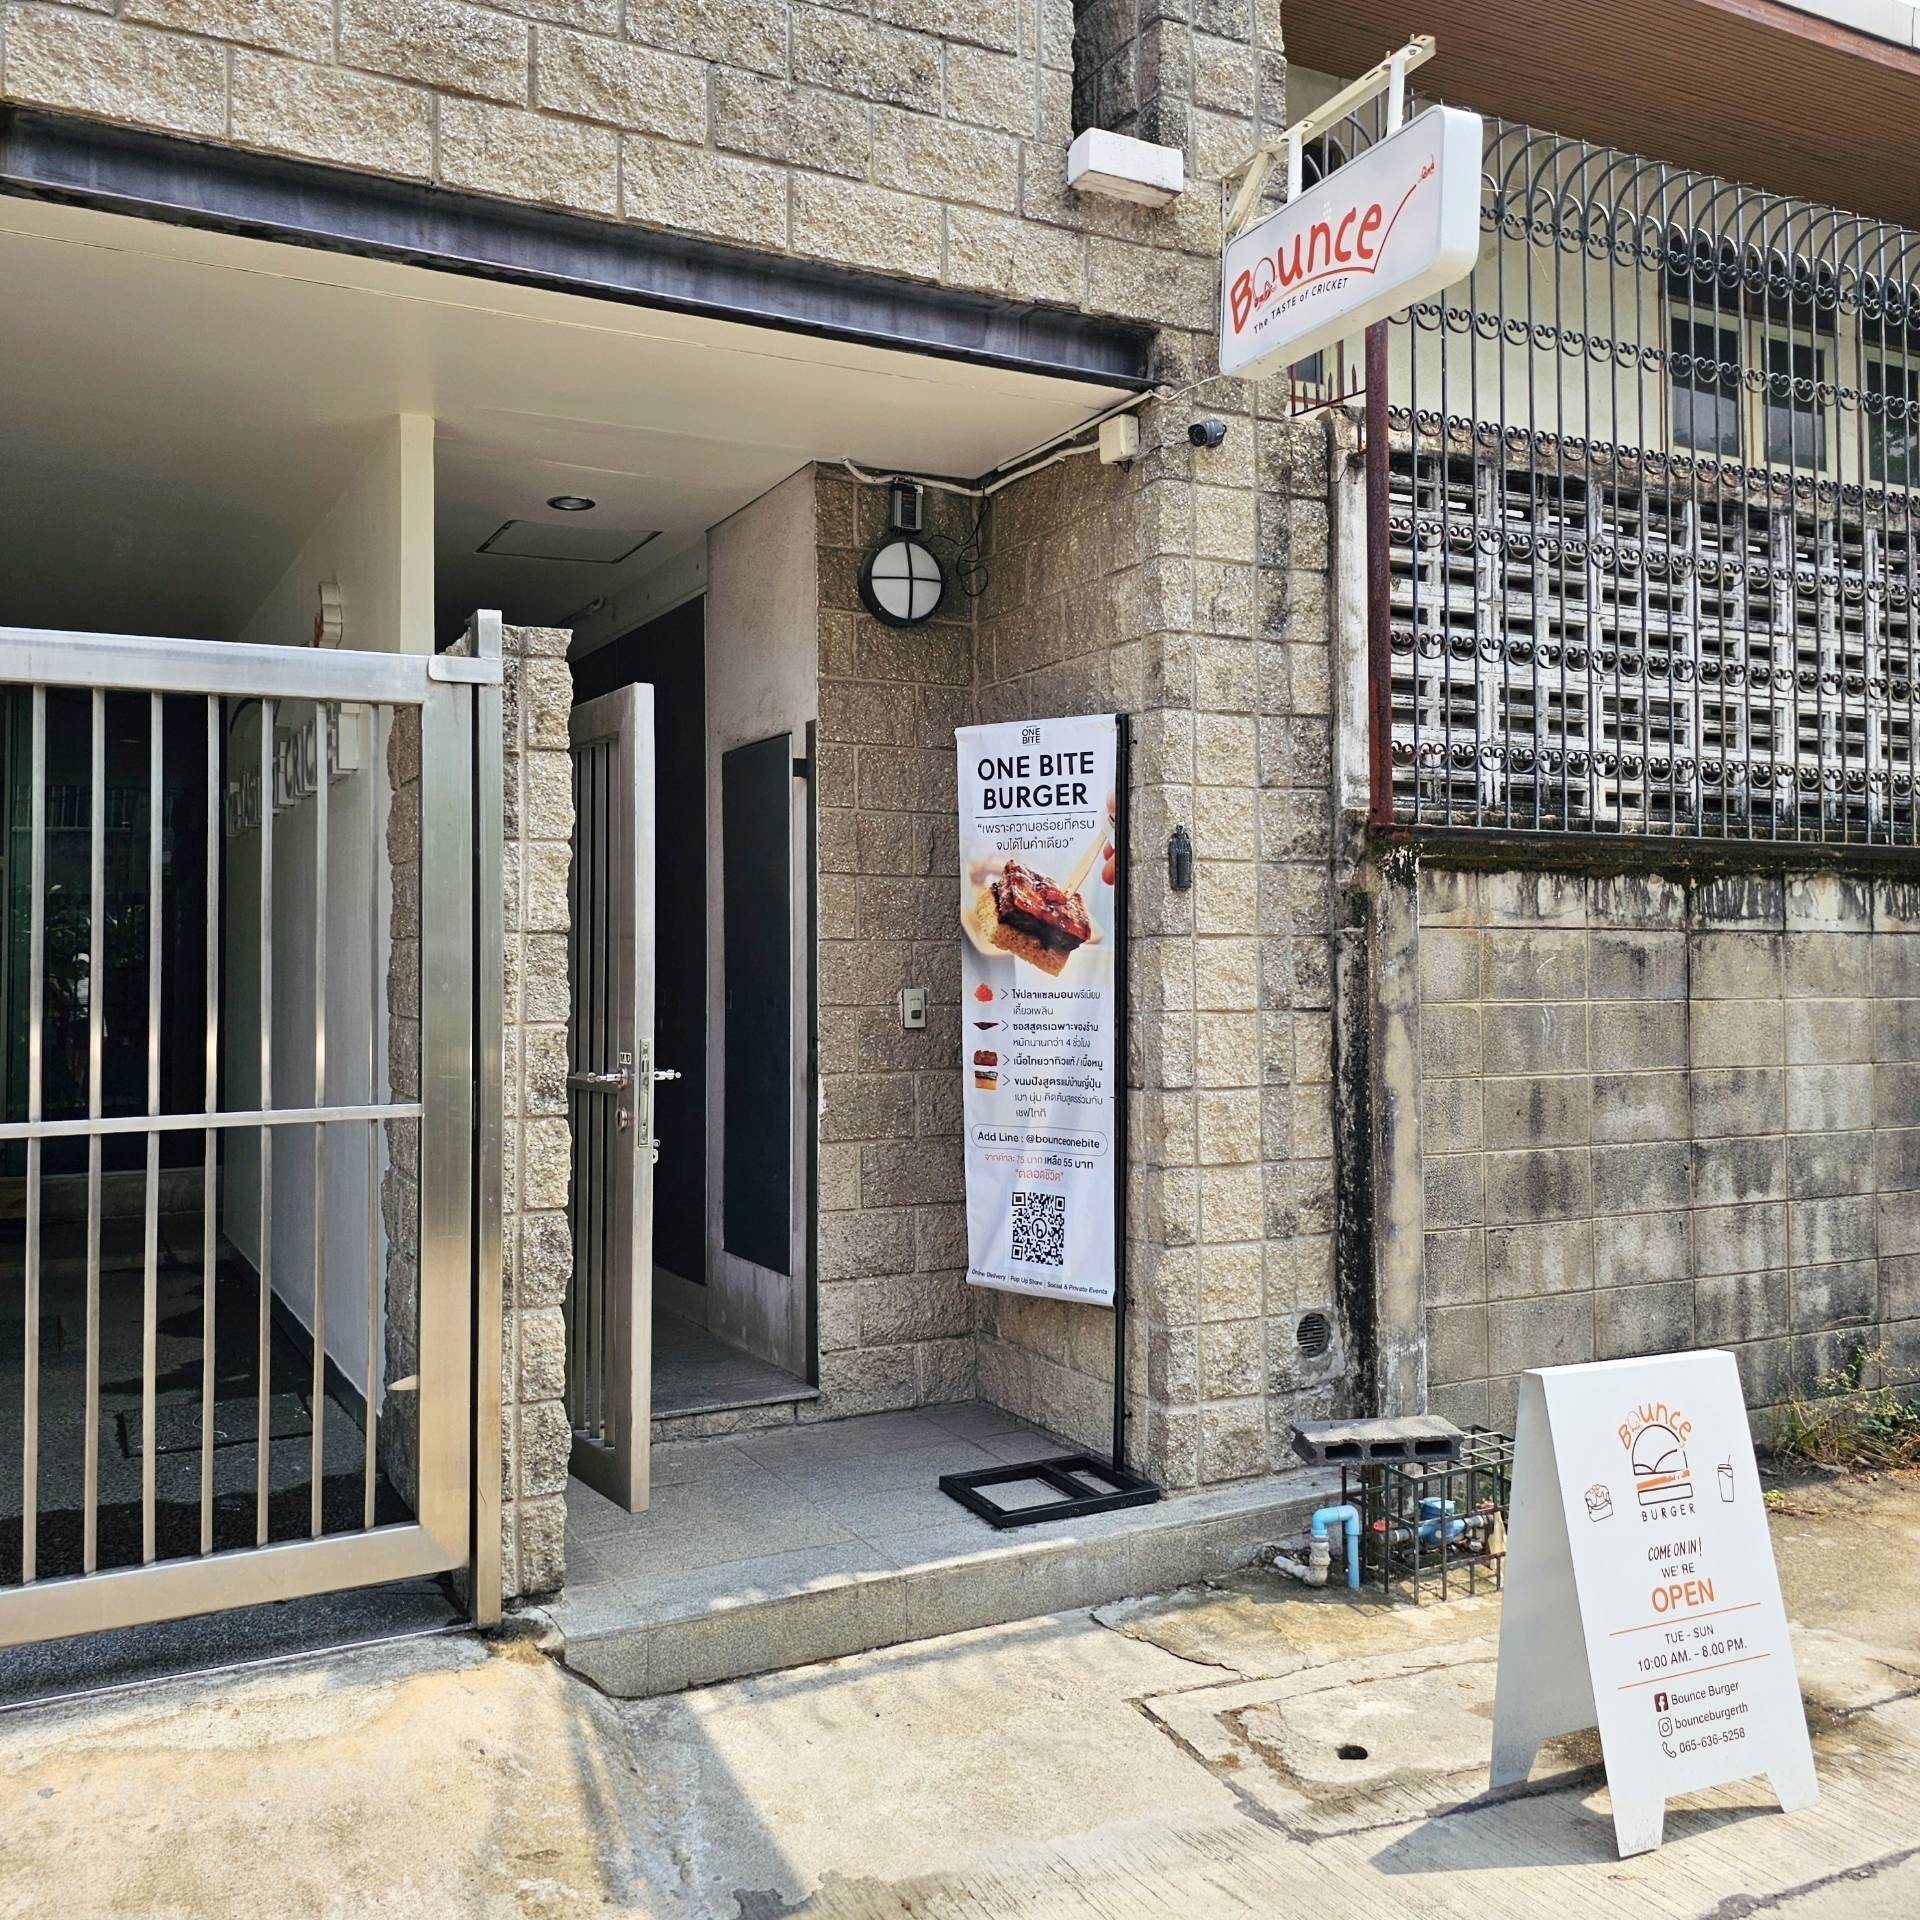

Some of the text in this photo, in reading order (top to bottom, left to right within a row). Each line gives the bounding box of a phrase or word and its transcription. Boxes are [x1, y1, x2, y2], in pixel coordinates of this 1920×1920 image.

[1254, 278, 1348, 334] The TASTE of CRICKET
[1022, 728, 1041, 737] ONE
[1022, 736, 1041, 745] BITE
[978, 752, 1094, 781] ONE BITE
[984, 783, 1088, 810] BURGER
[1066, 1039, 1071, 1047] 4
[978, 1131, 996, 1142] Add
[999, 1132, 1019, 1143] Line
[1026, 1134, 1100, 1149] @bounceonebite
[1063, 1157, 1073, 1167] 55
[1075, 1159, 1094, 1170] บาท
[986, 1271, 1006, 1281] Delivery
[1618, 1401, 1692, 1450] Bounce
[1641, 1503, 1696, 1522] BURGER
[1648, 1543, 1672, 1562] COME
[1673, 1541, 1686, 1556] ON
[1651, 1578, 1715, 1613] OPEN
[1665, 1631, 1684, 1645] TUE
[1693, 1624, 1714, 1640] SUN
[1638, 1653, 1668, 1672] 10:00
[1670, 1650, 1691, 1665] AM.
[1701, 1642, 1725, 1658] 8.00
[1726, 1637, 1747, 1652] PM.
[1671, 1681, 1739, 1706] Bounce Burger
[1675, 1702, 1748, 1729] bounceburgerth
[1679, 1727, 1746, 1753] 065-636-5258
